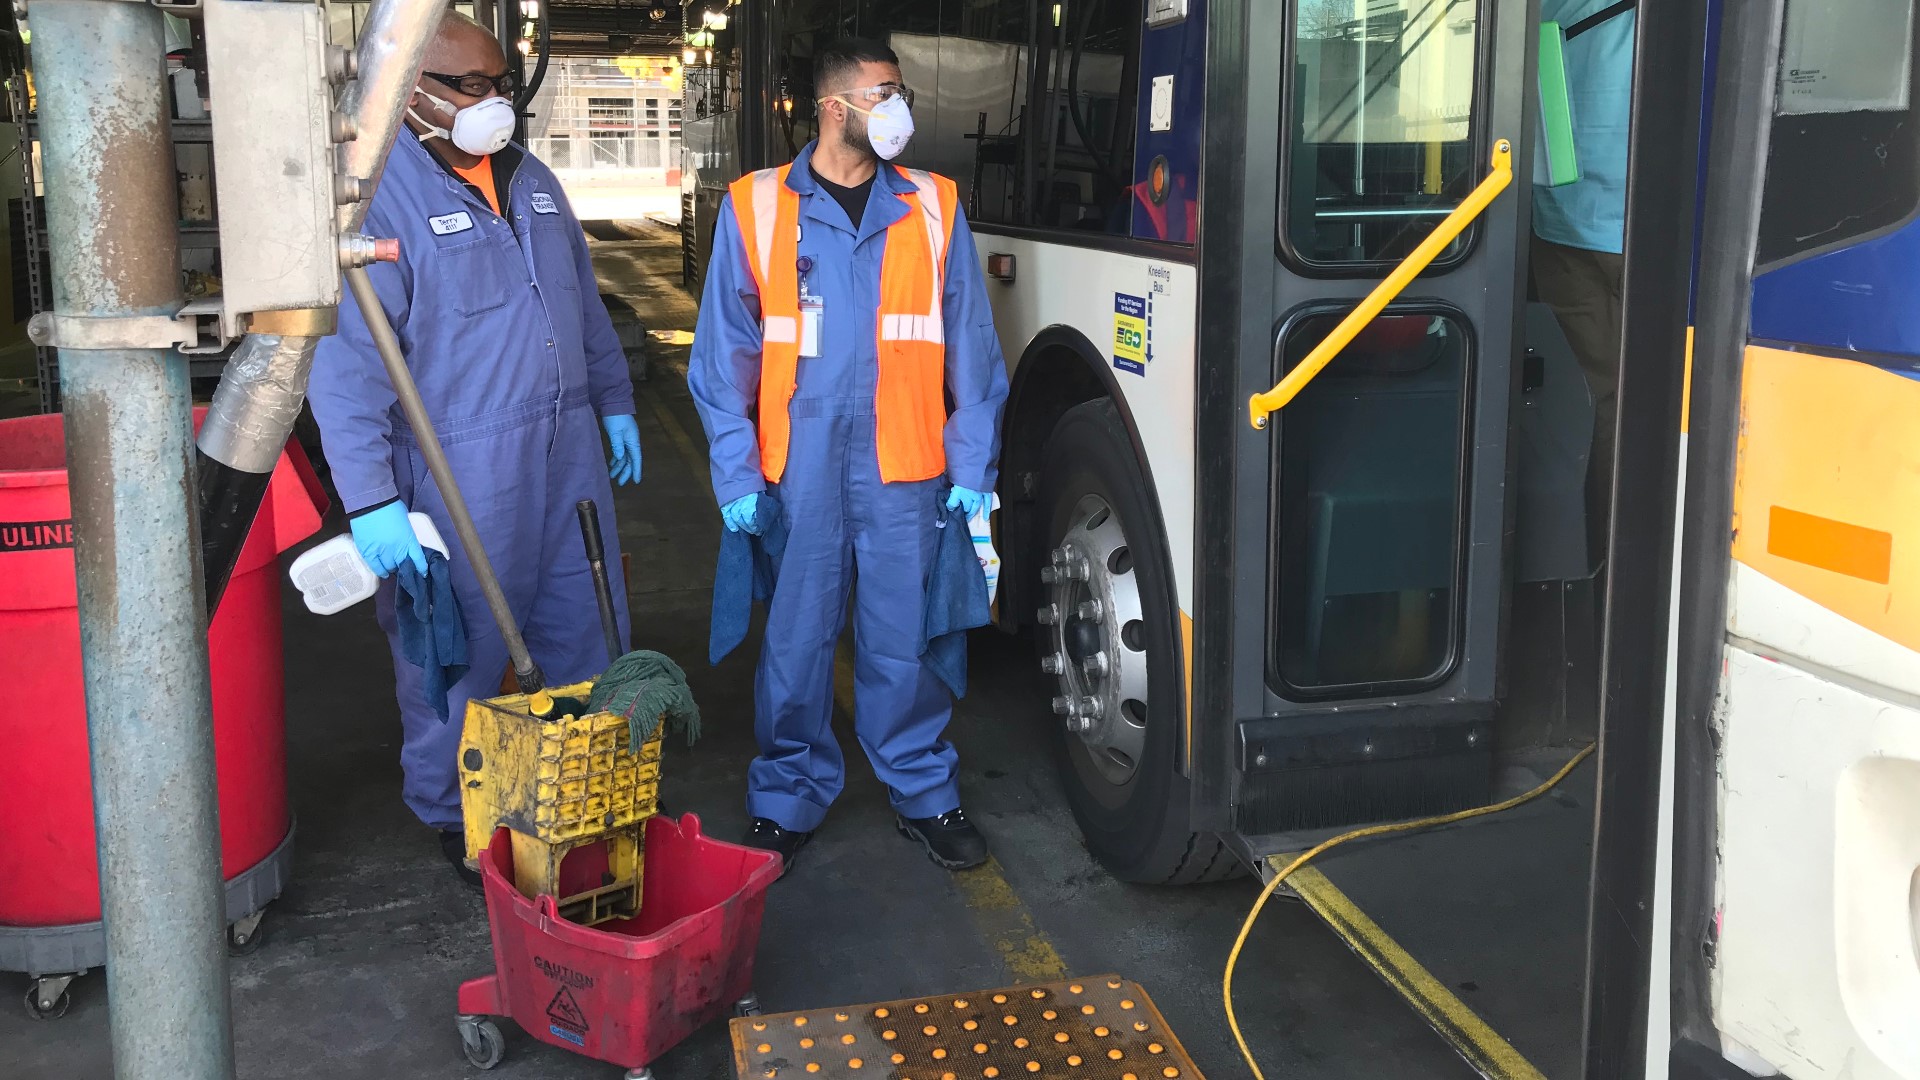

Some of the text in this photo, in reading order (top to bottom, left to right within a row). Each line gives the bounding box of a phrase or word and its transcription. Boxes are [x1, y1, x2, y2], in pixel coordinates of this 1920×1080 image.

[438, 217, 458, 226] Terry
[1148, 265, 1171, 282] Kneeling
[1154, 281, 1163, 293] Bus
[2, 524, 74, 547] ULINE
[534, 956, 594, 988] CAUTION
